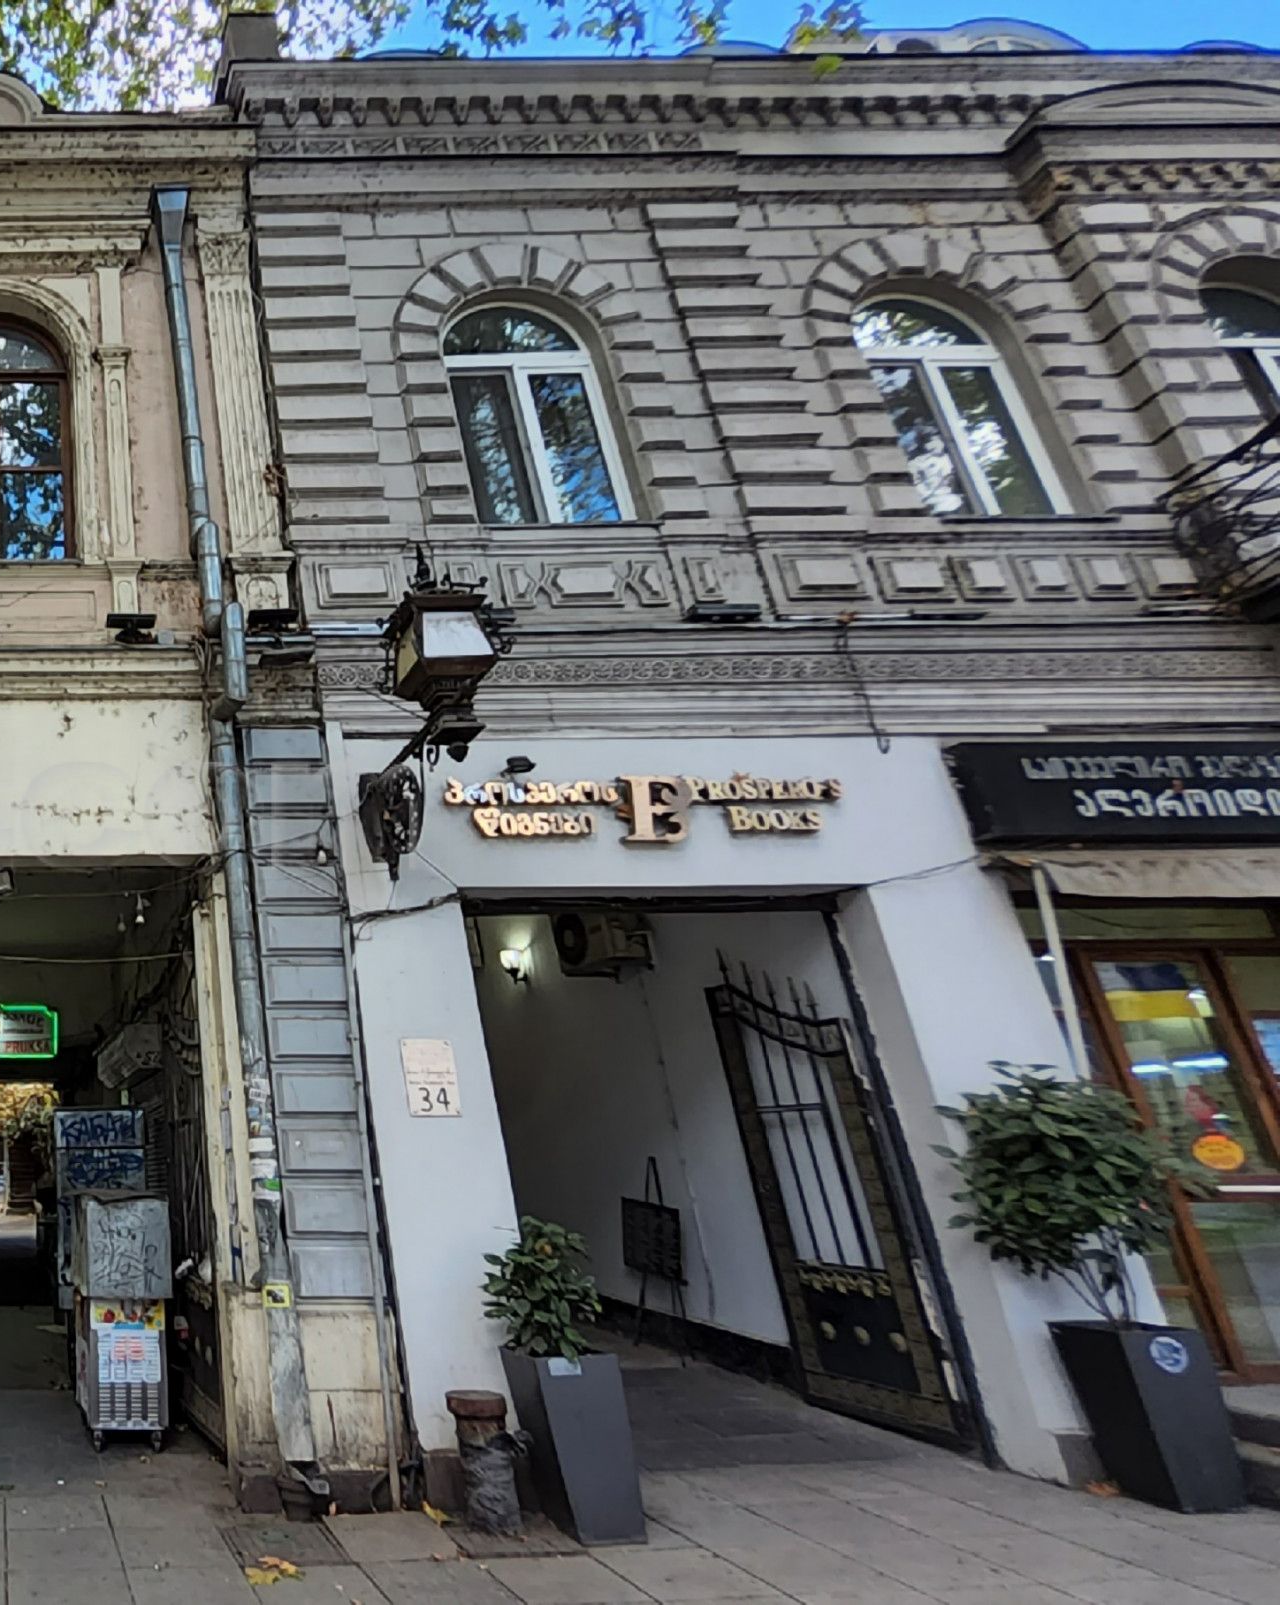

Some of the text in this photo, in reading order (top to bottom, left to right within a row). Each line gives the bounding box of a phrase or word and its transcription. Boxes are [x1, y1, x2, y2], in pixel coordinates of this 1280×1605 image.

[444, 777, 619, 805] პროსპეროს
[473, 807, 594, 837] წიგნები
[419, 1087, 451, 1112] 34
